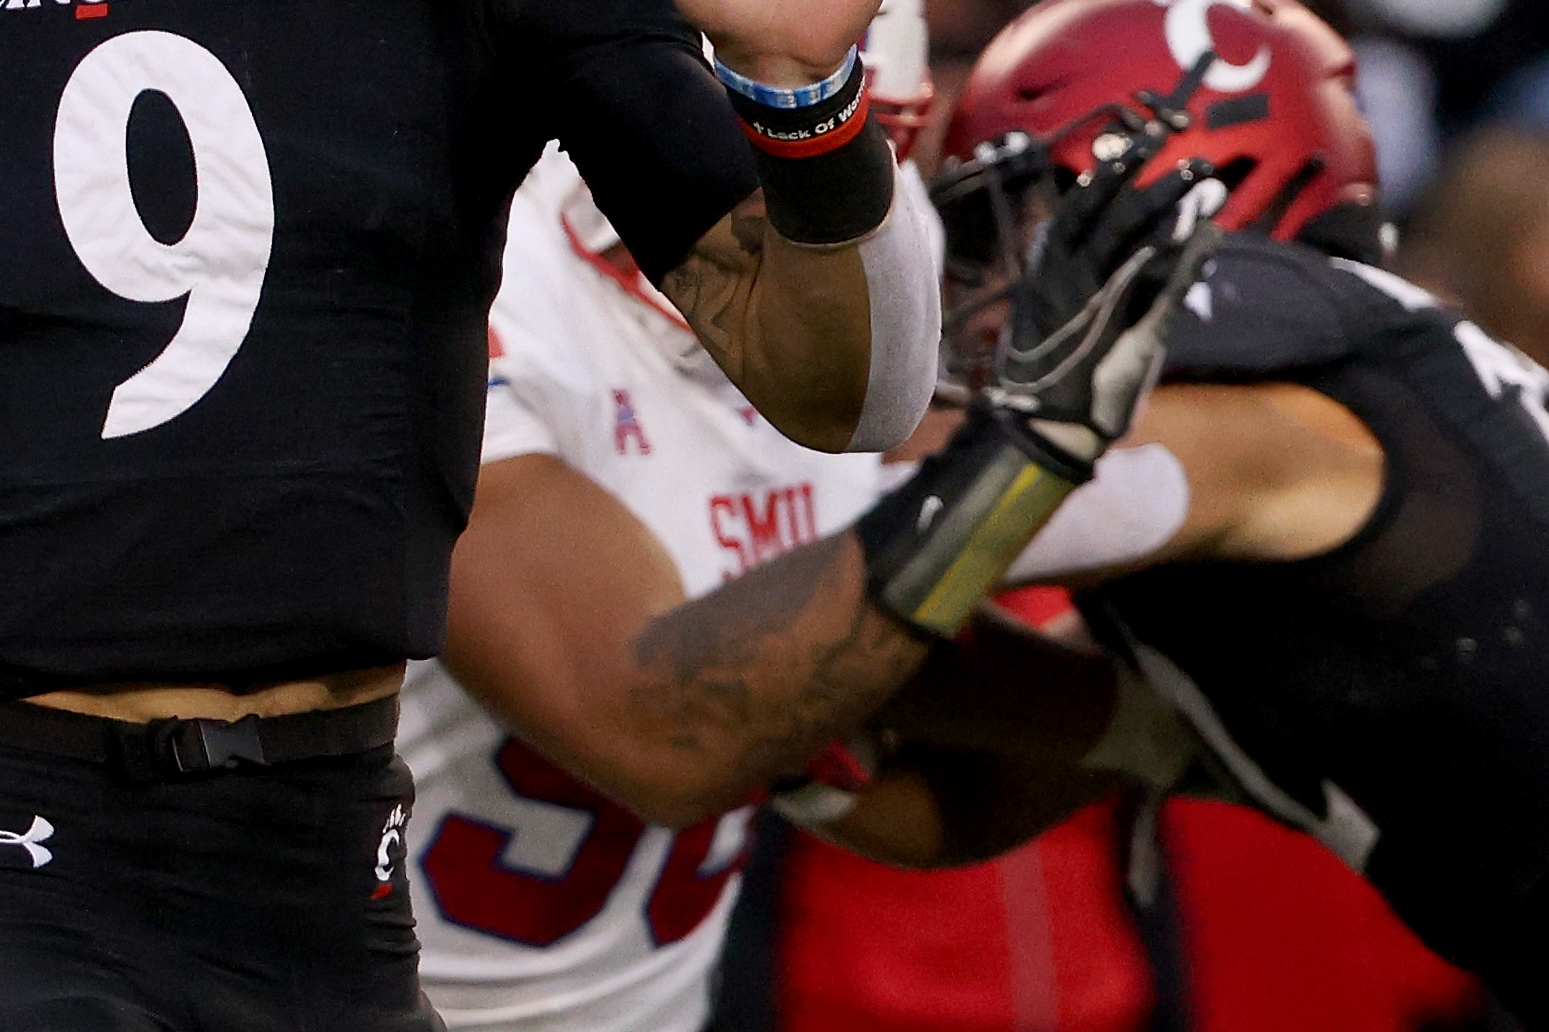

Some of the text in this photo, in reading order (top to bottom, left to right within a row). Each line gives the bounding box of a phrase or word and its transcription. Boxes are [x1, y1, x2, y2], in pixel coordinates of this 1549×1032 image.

[767, 128, 812, 141] Lack
[814, 117, 835, 135] Of
[53, 30, 275, 441] 9
[708, 482, 817, 581] SMU
